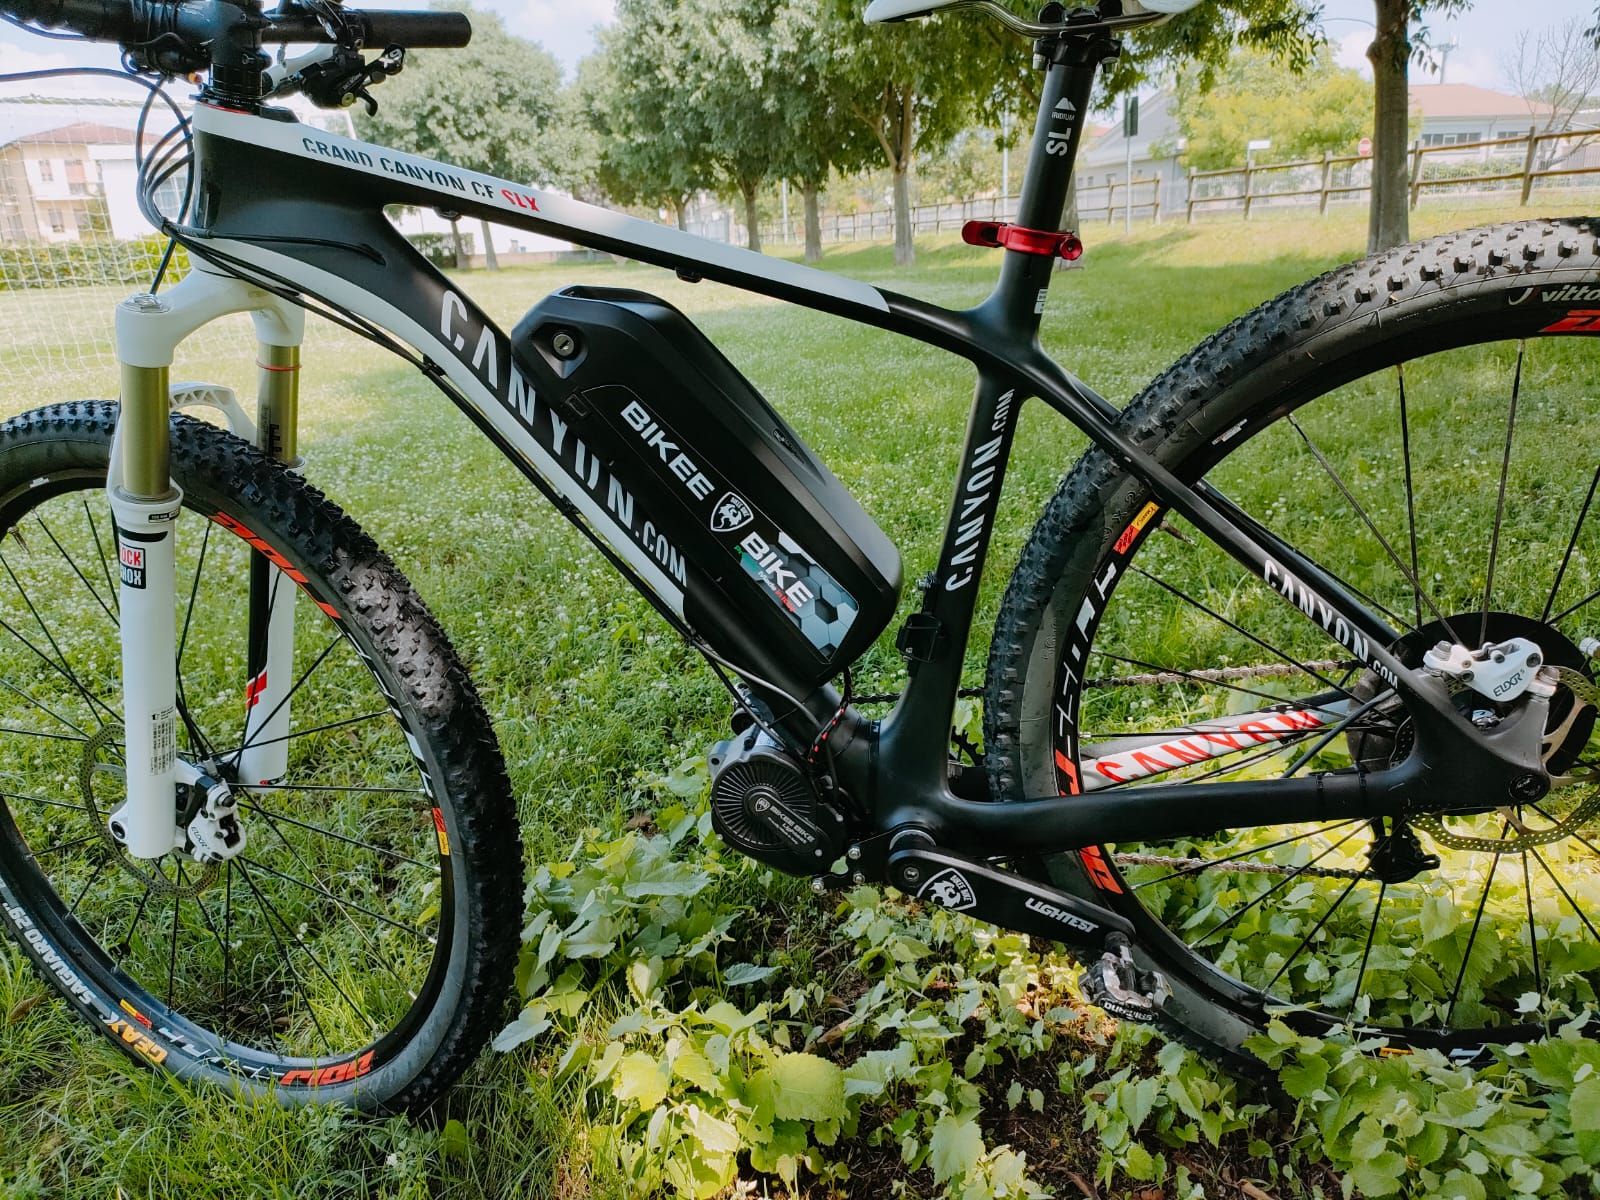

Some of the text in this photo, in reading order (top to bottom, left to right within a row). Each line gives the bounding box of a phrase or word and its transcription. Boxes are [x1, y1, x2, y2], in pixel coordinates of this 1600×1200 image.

[302, 137, 541, 212] GRAND CANYON CF SLX
[1045, 127, 1072, 156] SL
[620, 400, 715, 501] BIKEE
[119, 546, 141, 567] OCK
[740, 531, 814, 608] BIKE
[1095, 710, 1325, 784] CANYON
[1024, 897, 1100, 933] LIGHTEST
[24, 928, 98, 1005] SAGUARO
[100, 1012, 168, 1064] GEAX
